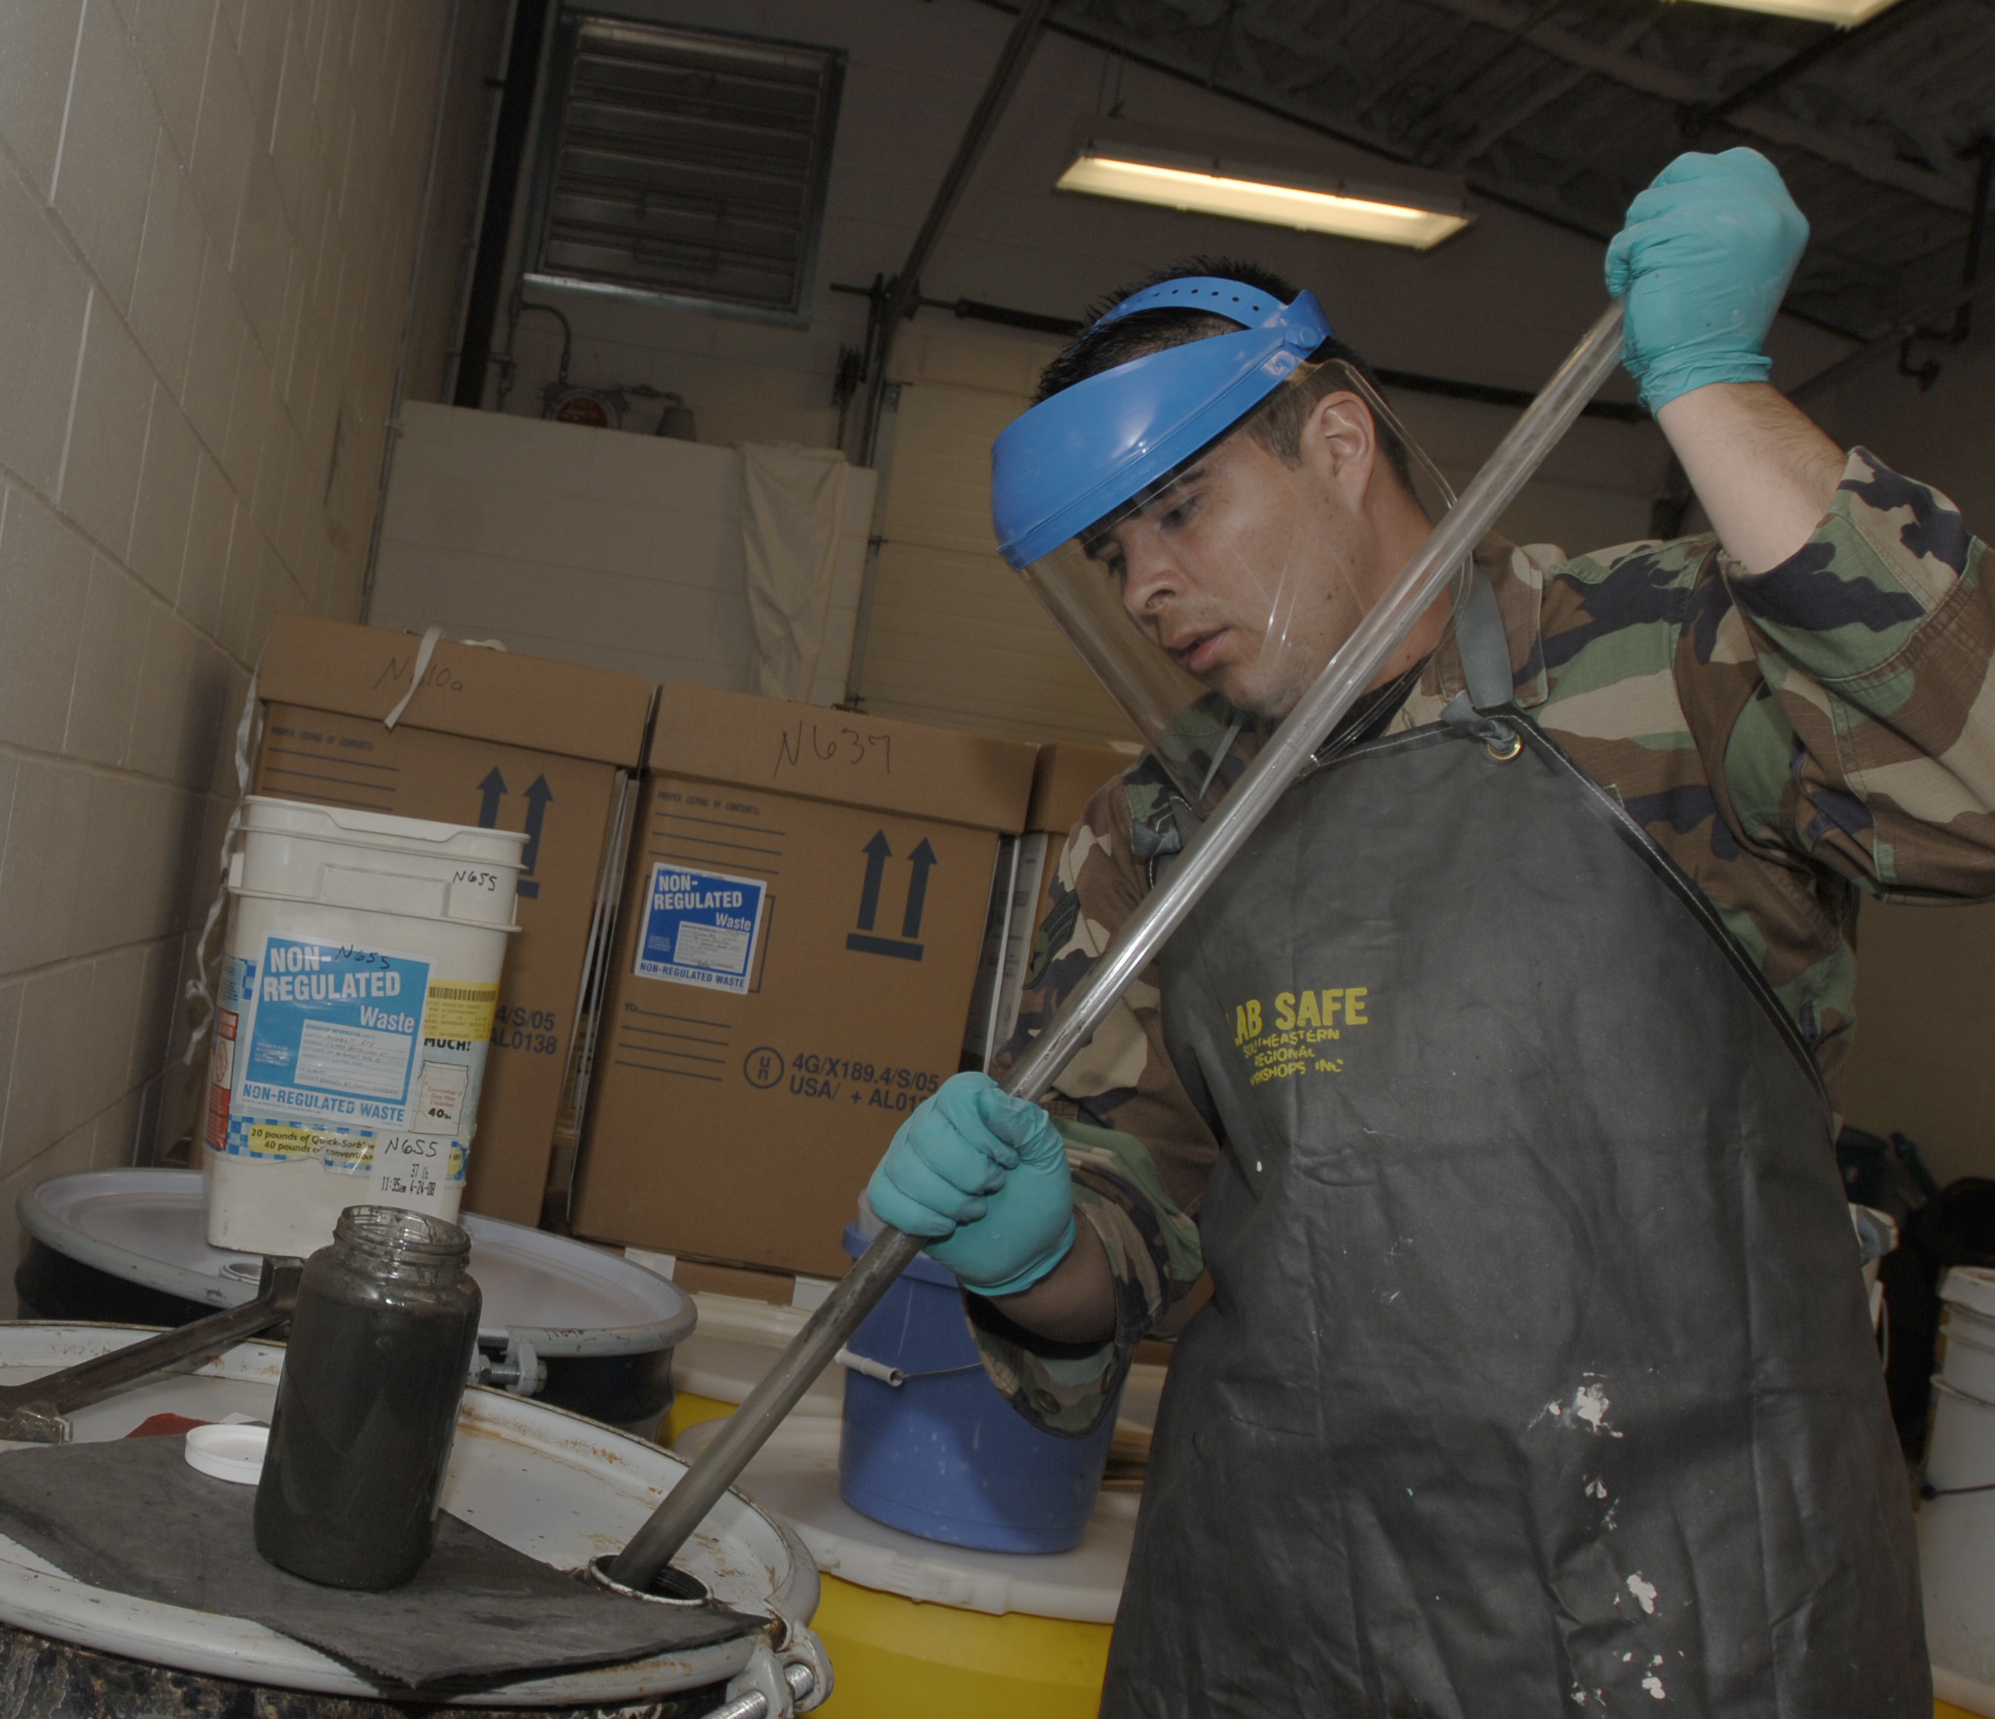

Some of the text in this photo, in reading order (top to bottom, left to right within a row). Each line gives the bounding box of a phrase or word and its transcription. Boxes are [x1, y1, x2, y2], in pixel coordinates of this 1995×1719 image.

[773, 720, 891, 779] N637
[452, 870, 497, 891] N655
[659, 874, 699, 892] NON-
[654, 891, 743, 910] REGULATED
[716, 912, 751, 931] Waste
[271, 946, 332, 973] NON-
[335, 944, 391, 970] N655
[263, 971, 402, 1002] REGULATED
[640, 962, 713, 983] NON-REGULATED
[715, 974, 745, 989] WASTE
[360, 1005, 415, 1034] Waste
[496, 1005, 557, 1031] 4/S/05
[1233, 987, 1369, 1047] AB SAFE
[1254, 1045, 1316, 1067] REGIONAL
[243, 1083, 355, 1115] NON-REGULATED
[360, 1102, 405, 1122] WASTE
[789, 1074, 841, 1100] USA/
[868, 1088, 928, 1112] AL01
[250, 1127, 263, 1137] 20
[265, 1129, 297, 1141] pounds
[300, 1134, 311, 1144] of
[264, 1140, 275, 1149] 40
[278, 1141, 310, 1153] pounds
[384, 1136, 438, 1157] N655
[410, 1163, 429, 1180] 37 lb
